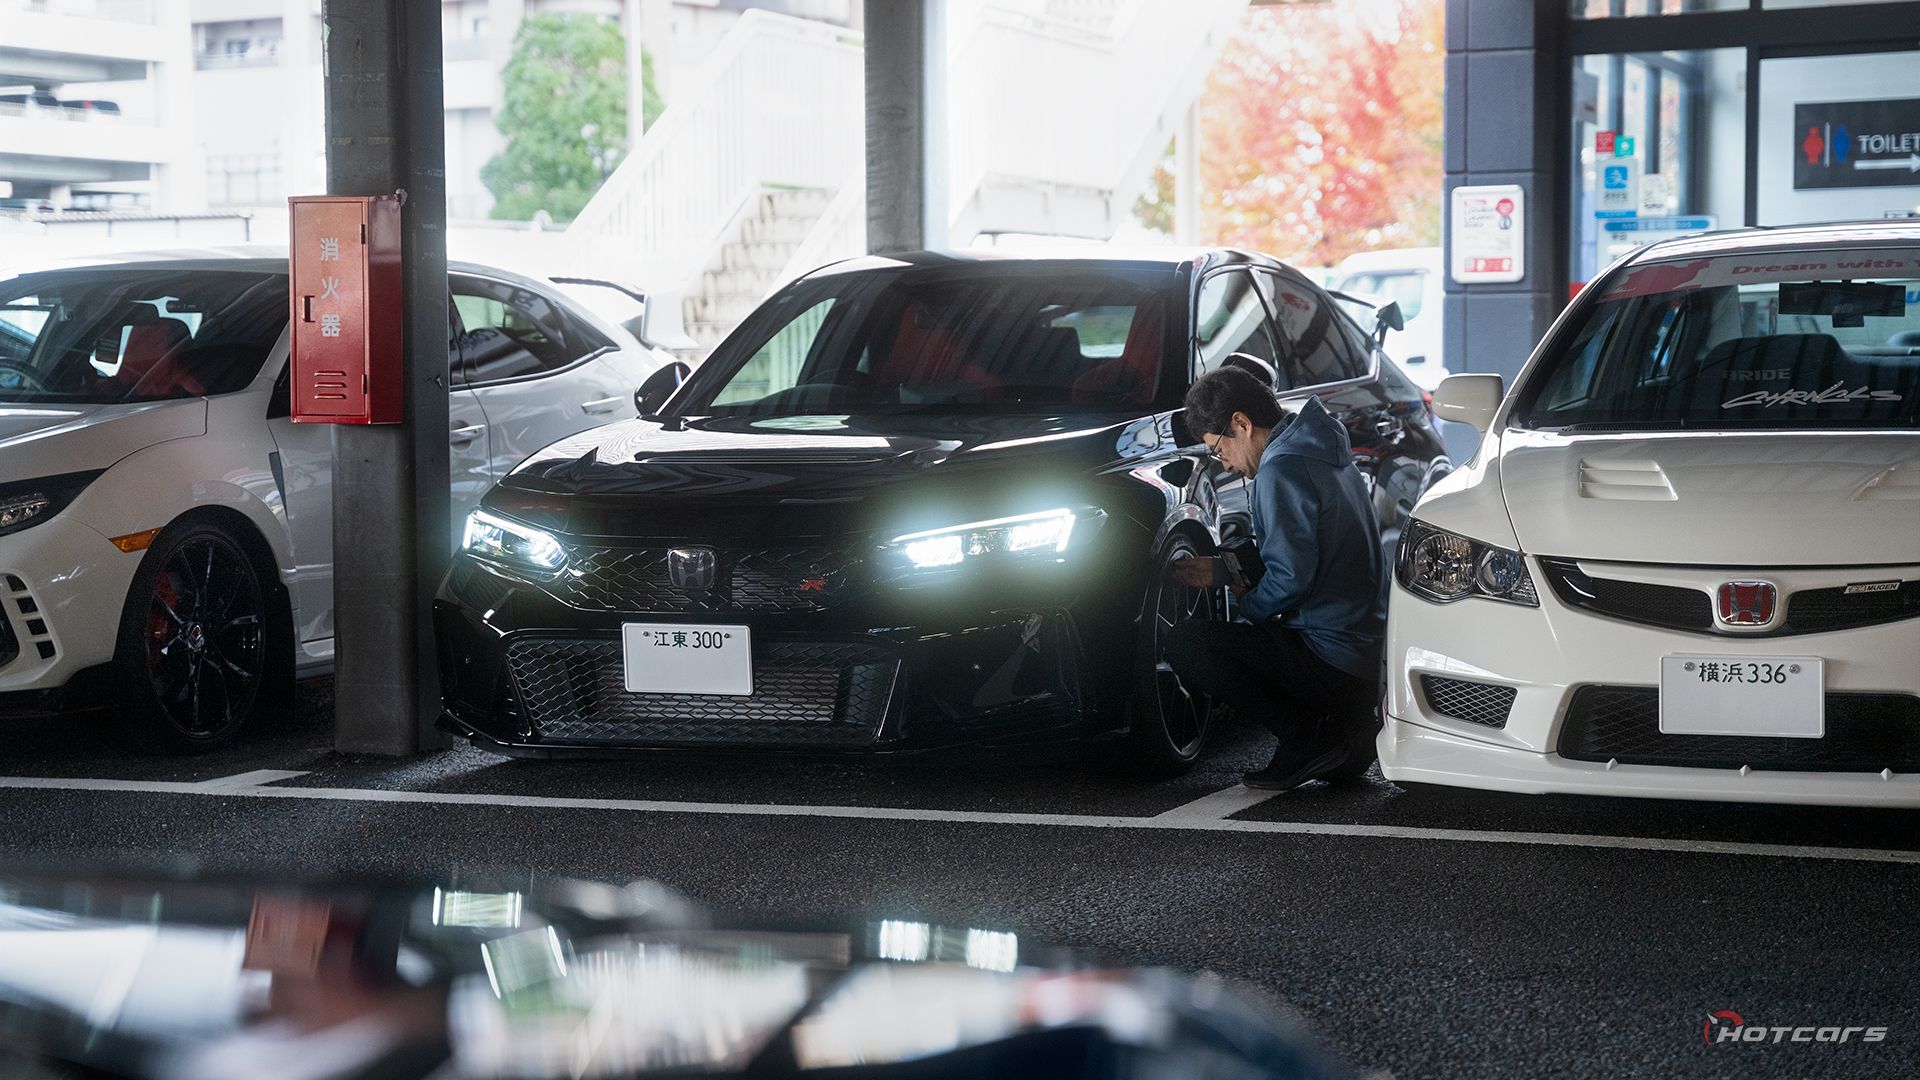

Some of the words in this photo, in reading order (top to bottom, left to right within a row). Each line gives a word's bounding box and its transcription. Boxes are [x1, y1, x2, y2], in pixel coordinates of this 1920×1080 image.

[1857, 133, 1920, 153] TOILET
[1731, 262, 1827, 275] Dream
[1836, 259, 1904, 269] with
[320, 237, 341, 337] 消火器
[1867, 583, 1898, 591] MUGEN
